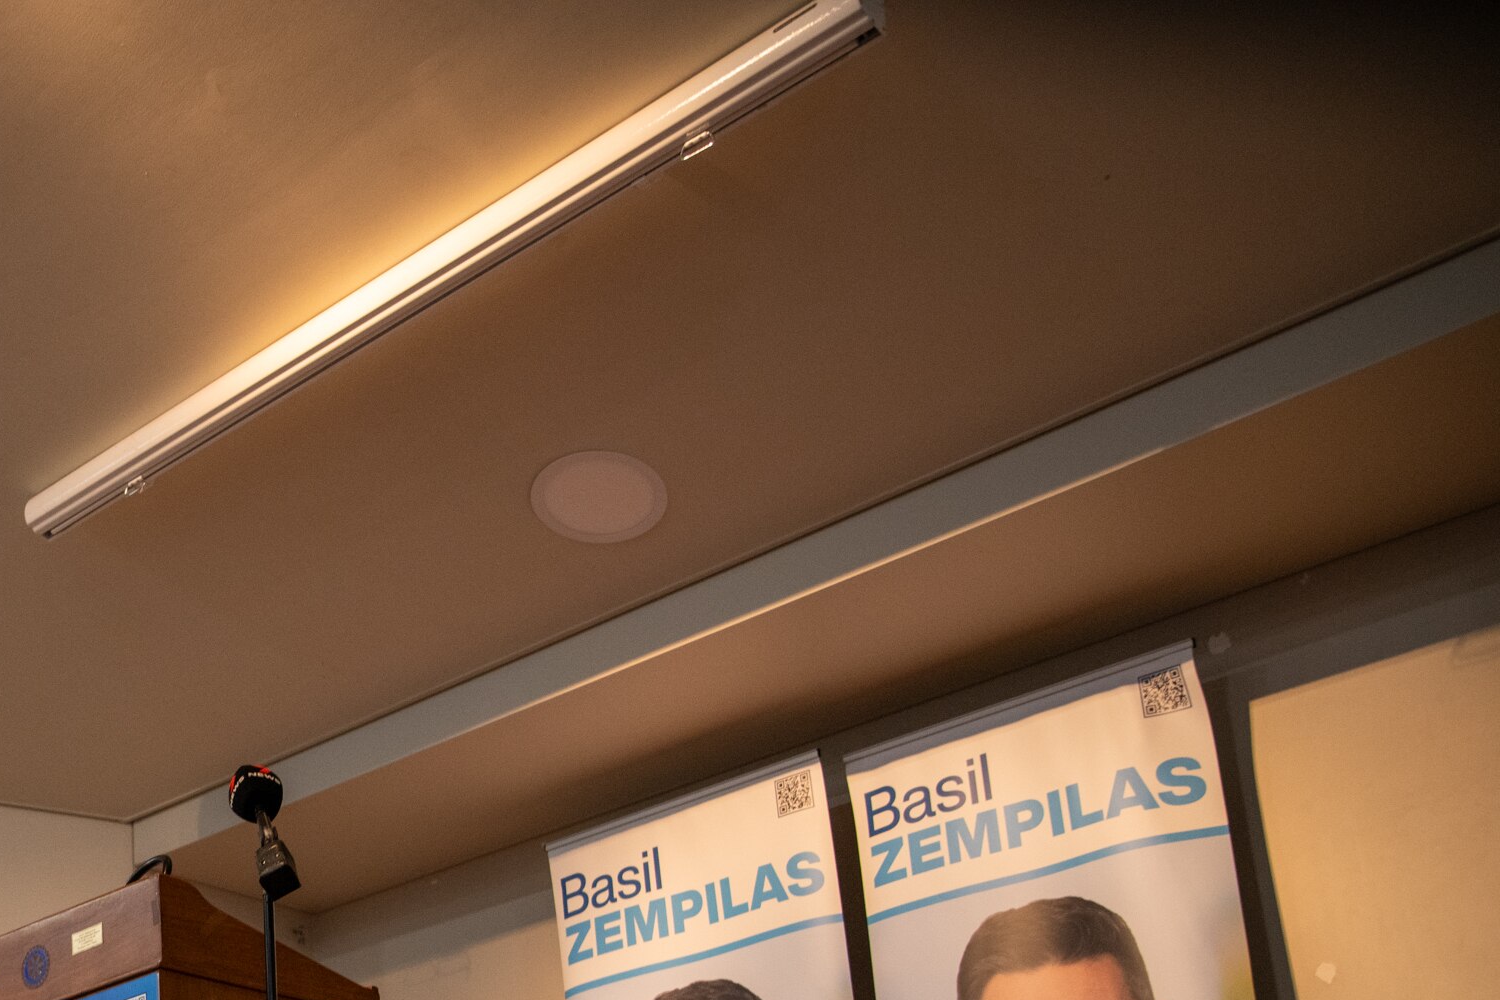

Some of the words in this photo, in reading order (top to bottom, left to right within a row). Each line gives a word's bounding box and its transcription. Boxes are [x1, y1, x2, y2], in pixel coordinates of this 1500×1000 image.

[864, 752, 993, 838] Basil
[871, 756, 1208, 889] ZEMPILAS
[560, 846, 663, 920] Basil
[565, 851, 825, 967] ZEMPILAS
